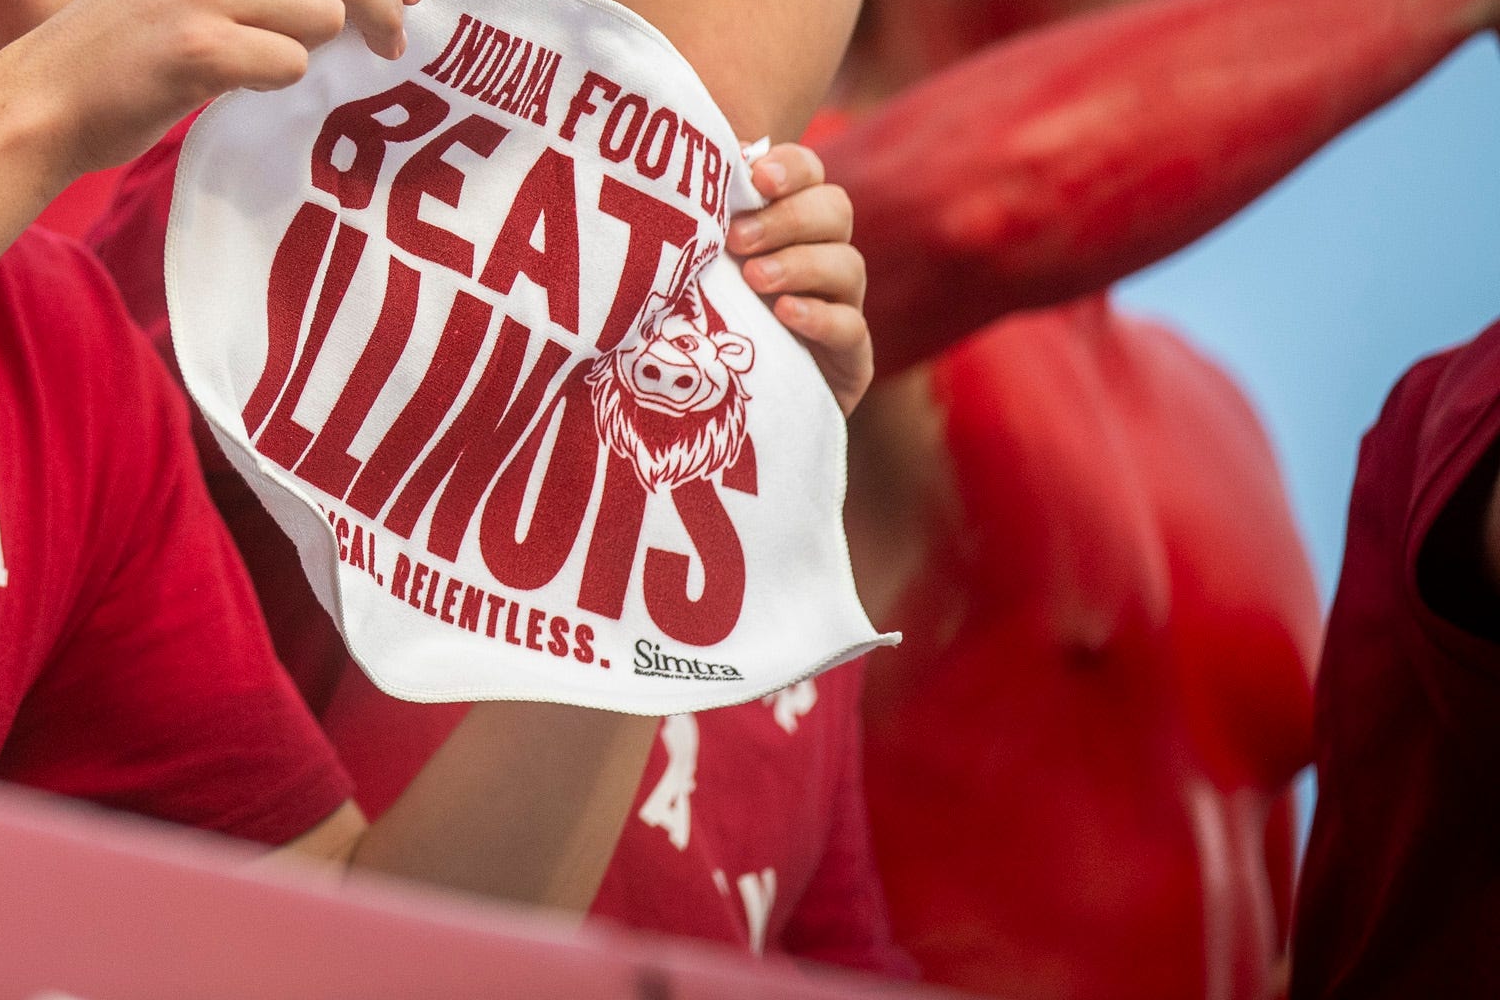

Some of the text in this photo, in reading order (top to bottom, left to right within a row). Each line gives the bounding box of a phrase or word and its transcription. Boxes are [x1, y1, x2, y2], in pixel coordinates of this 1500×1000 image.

[421, 14, 563, 127] INDIANA
[312, 81, 698, 353] BEAT
[242, 201, 759, 647] ILLINOIS
[390, 552, 611, 669] RELENTLESS.
[633, 639, 742, 676] Simtra
